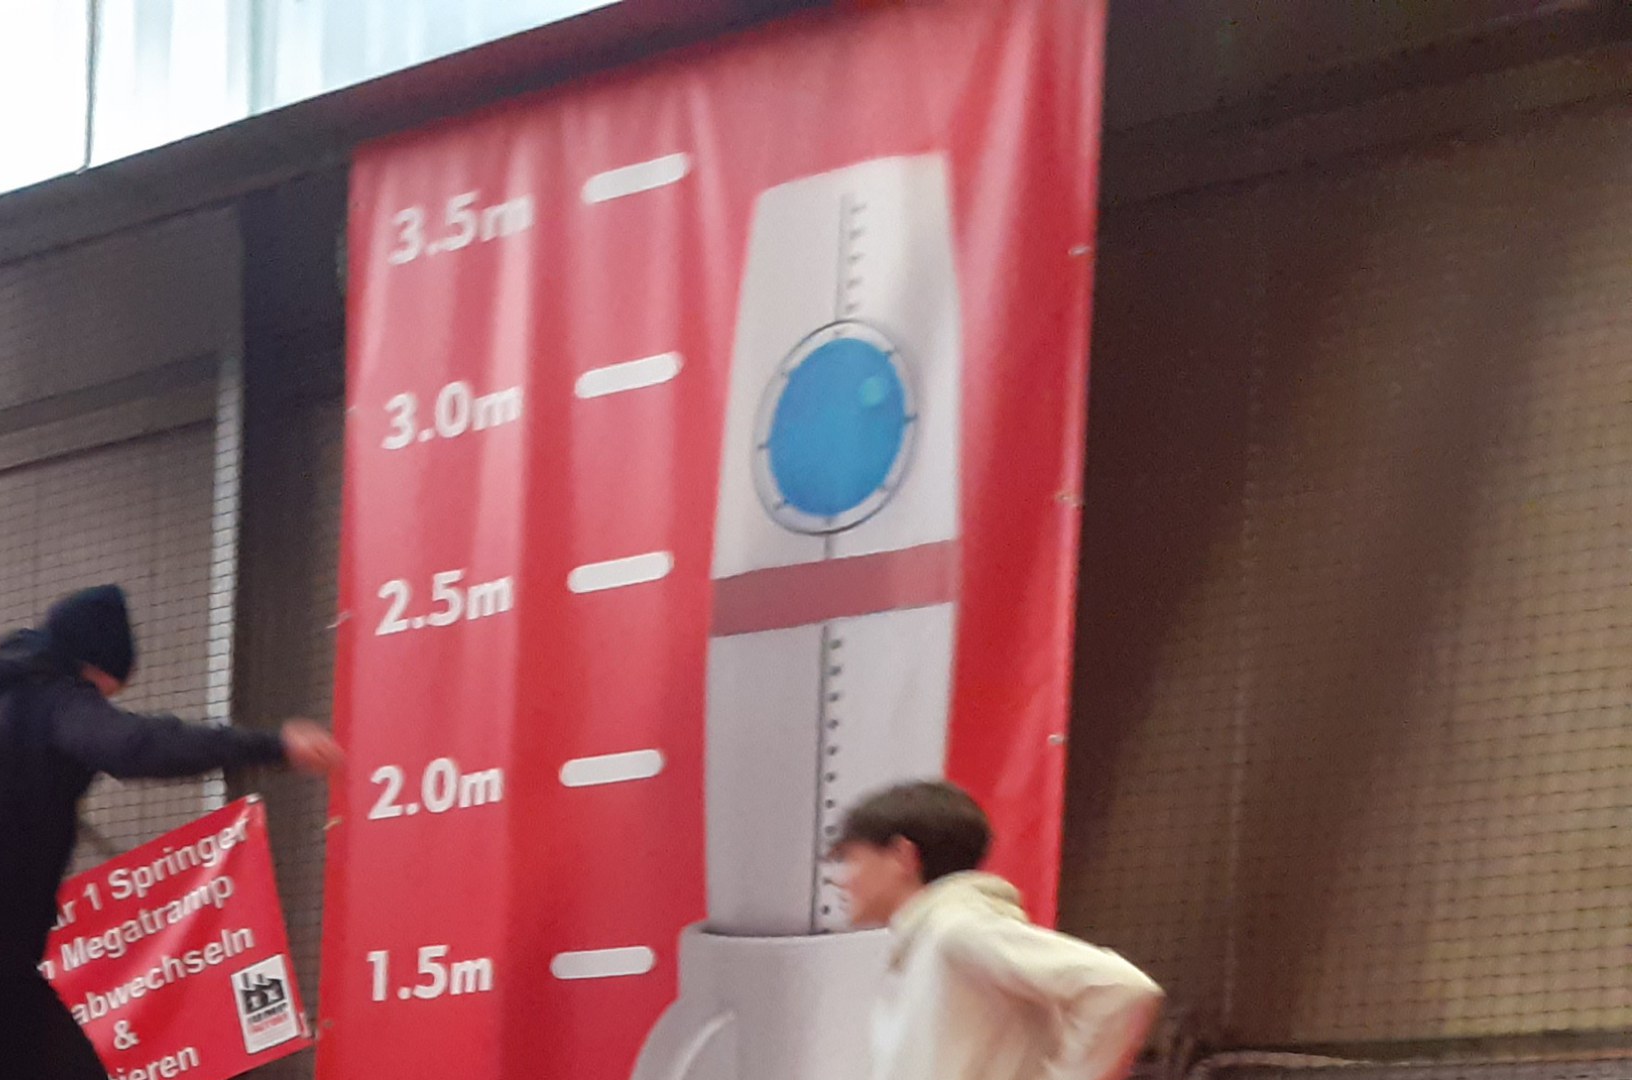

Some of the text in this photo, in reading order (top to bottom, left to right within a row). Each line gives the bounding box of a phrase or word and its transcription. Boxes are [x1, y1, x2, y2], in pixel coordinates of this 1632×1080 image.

[389, 190, 535, 265] 3.5m
[381, 380, 525, 450] 3.0m
[375, 569, 514, 636] 2.5m
[368, 757, 504, 820] 2.0m
[82, 882, 104, 911] 1
[108, 815, 250, 900] Springer
[60, 873, 235, 972] Megatramp
[70, 926, 255, 1025] abwechseln
[366, 945, 493, 1001] 1.5m
[113, 1019, 141, 1050] &
